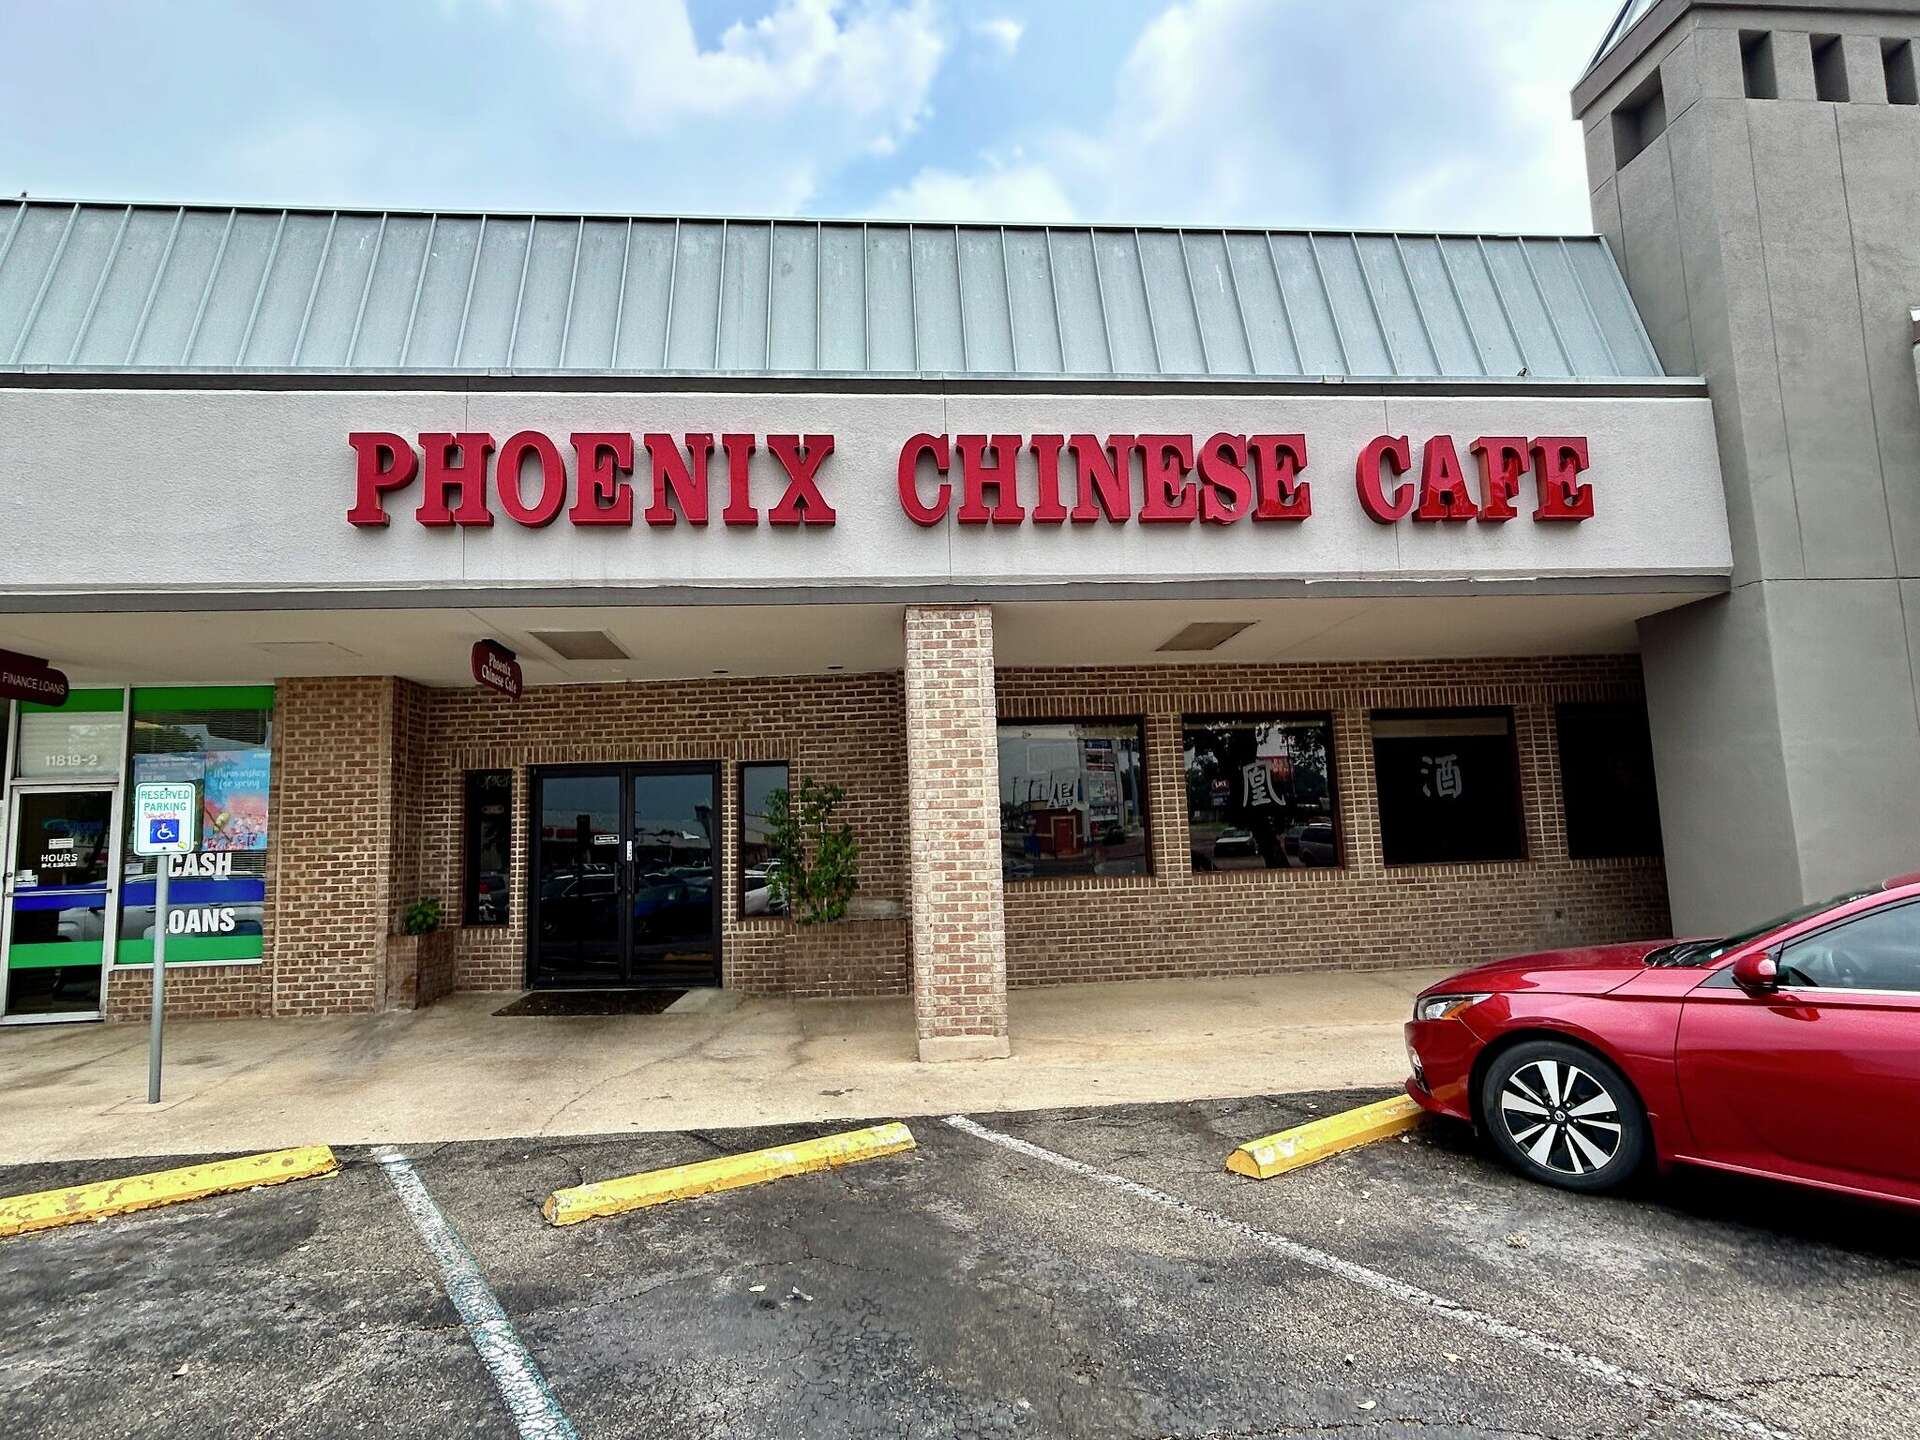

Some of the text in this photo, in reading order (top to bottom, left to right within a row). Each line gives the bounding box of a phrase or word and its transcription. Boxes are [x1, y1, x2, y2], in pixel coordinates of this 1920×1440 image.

[347, 430, 1595, 528] PHOENIX CHINESE CAFE
[481, 664, 504, 687] Chinese
[488, 652, 511, 677] Phoenix
[2, 672, 65, 695] FINANCE LOANS
[45, 754, 98, 767] 11819-2
[1242, 761, 1287, 808] 凰
[1420, 753, 1463, 799] 酒
[140, 790, 190, 800] RESERVED
[143, 802, 187, 812] PARKING
[41, 853, 79, 862] HOURS
[167, 852, 233, 877] CASH
[165, 907, 236, 934] OANS
